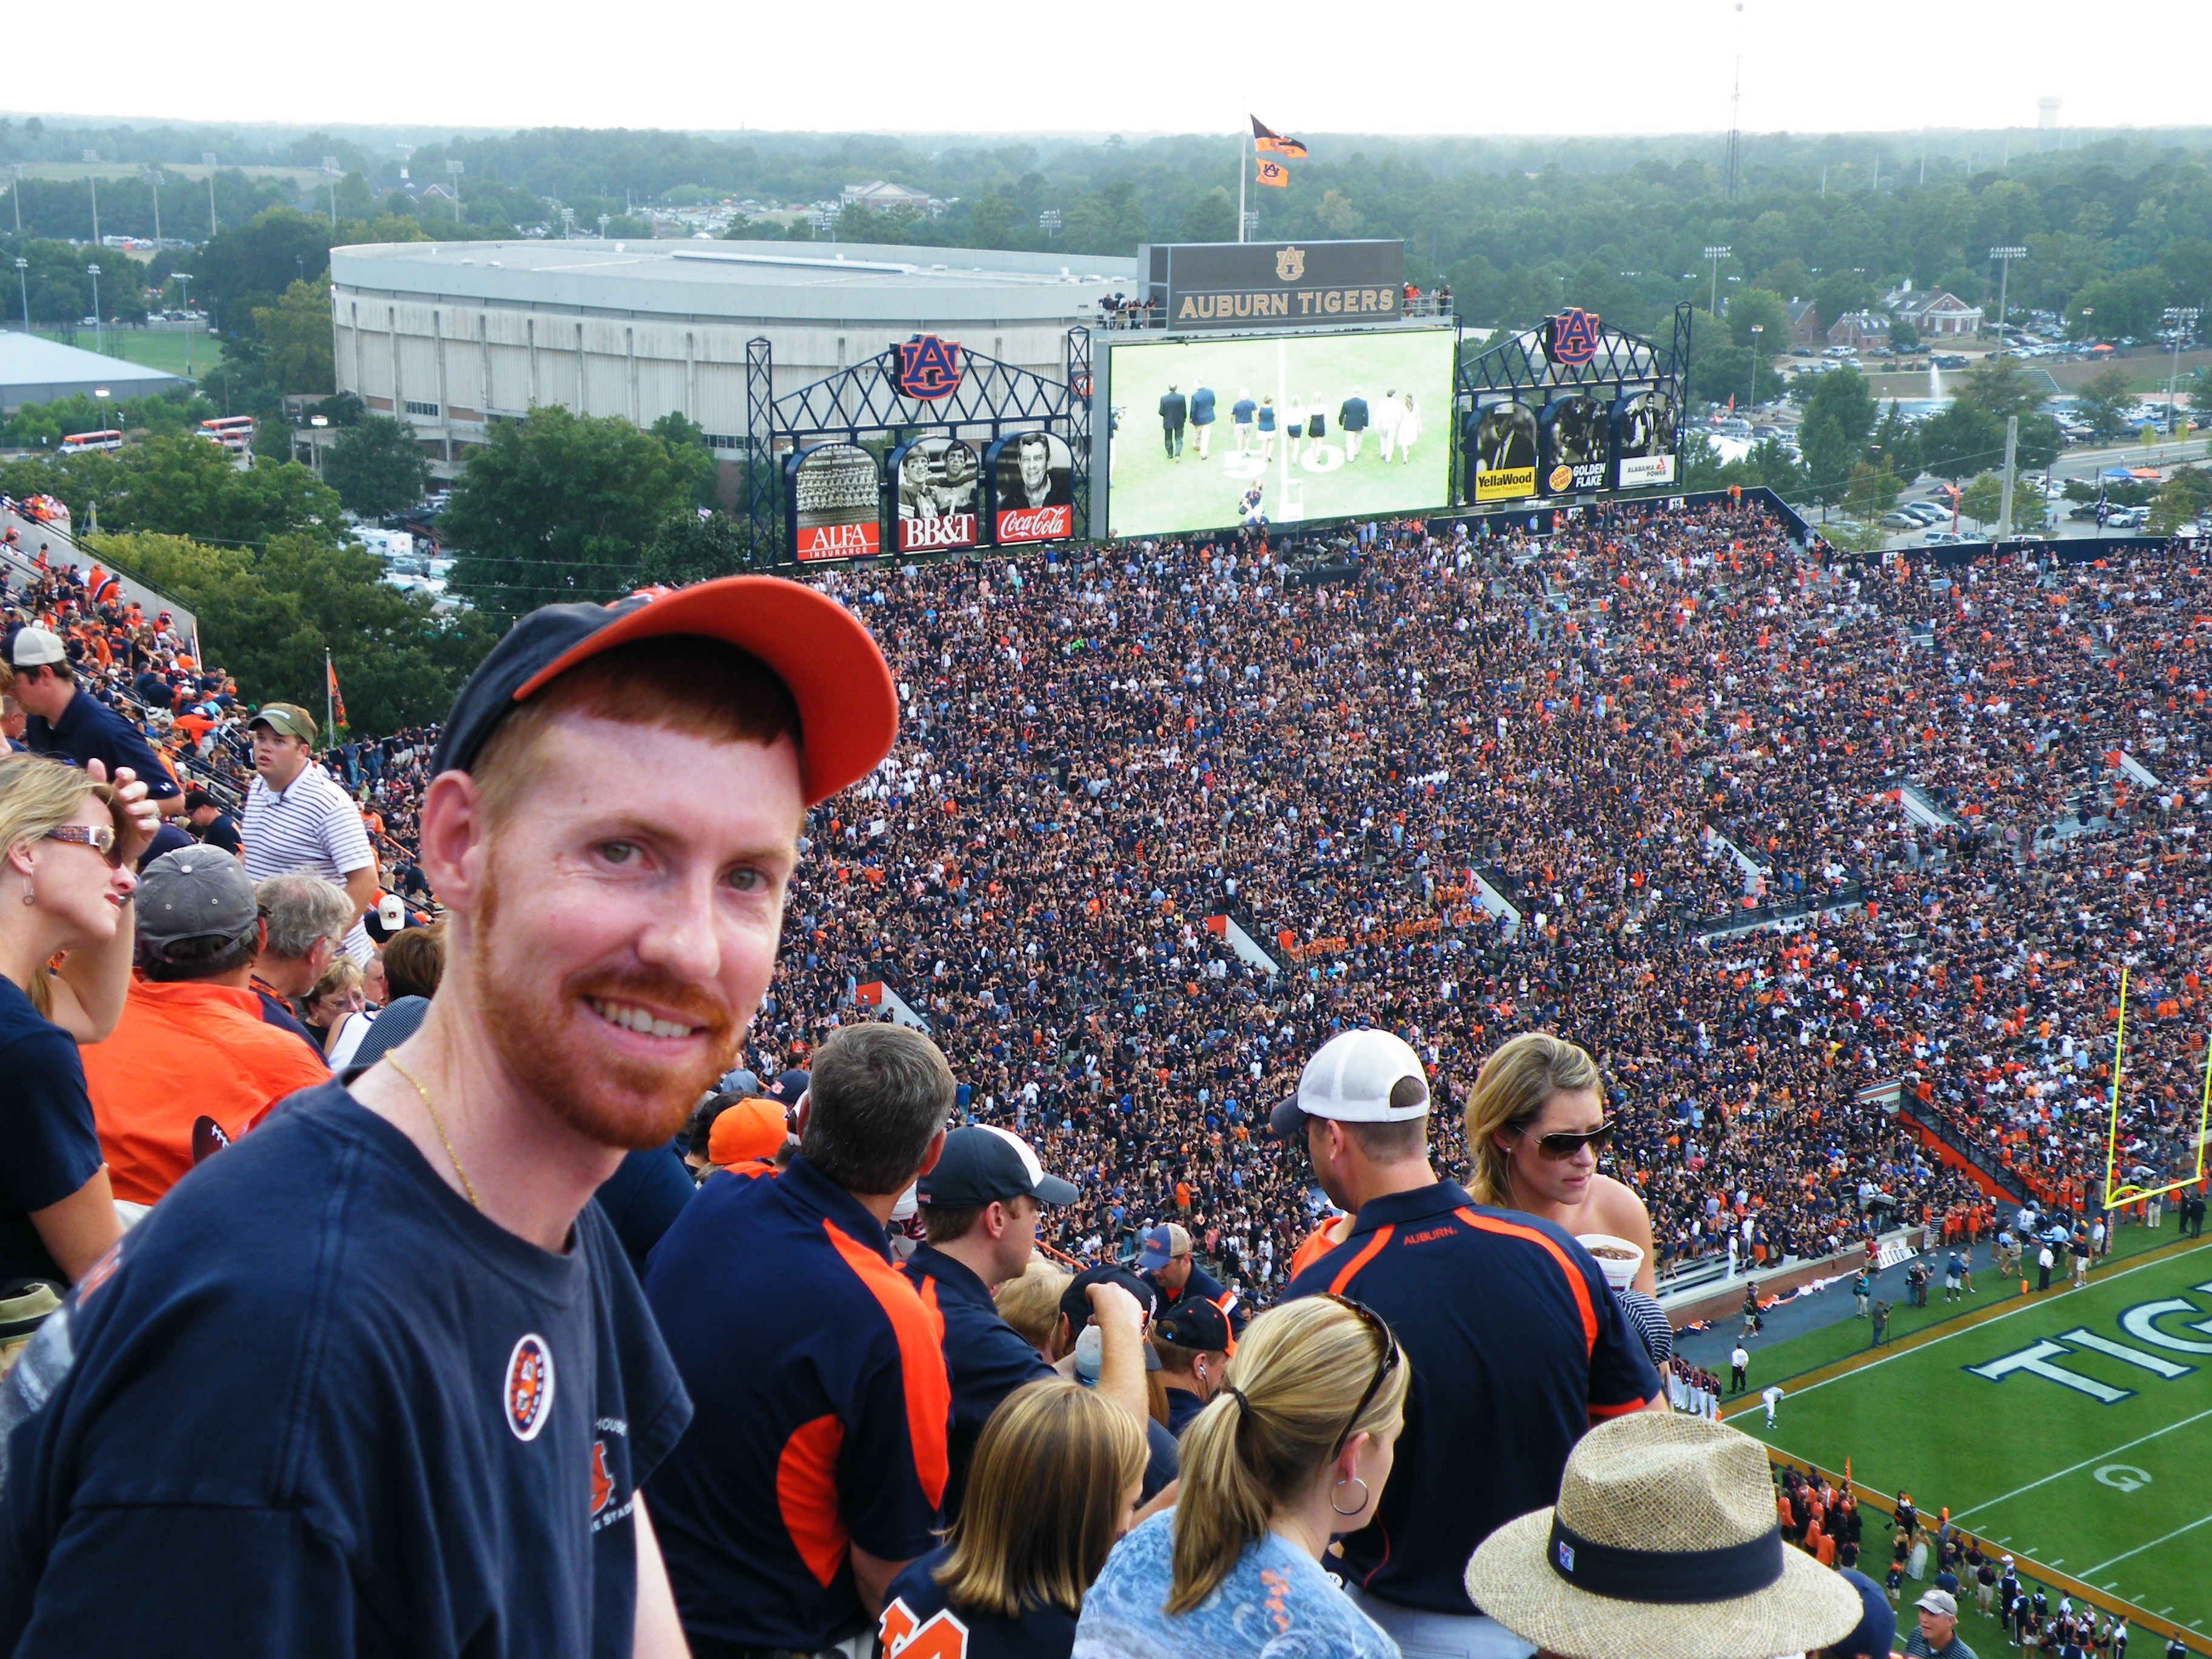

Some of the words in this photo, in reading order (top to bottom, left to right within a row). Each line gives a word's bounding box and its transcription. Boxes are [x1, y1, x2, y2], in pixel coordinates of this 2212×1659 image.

[1179, 293, 1289, 319] AUBURN
[1298, 289, 1394, 314] TIGERS
[1573, 462, 1606, 477] GOLDEN
[1627, 464, 1655, 473] ALABAMA
[1478, 471, 1532, 488] YellaWood
[1575, 475, 1603, 488] FLAKE
[1672, 499, 1681, 508] 15
[811, 523, 868, 550] ALFA
[905, 513, 975, 548] BB&T
[809, 546, 868, 558] INSURANCE
[1403, 1227, 1453, 1246] AUBURN
[1960, 1279, 2212, 1406] TIG
[2093, 1464, 2153, 1493] G
